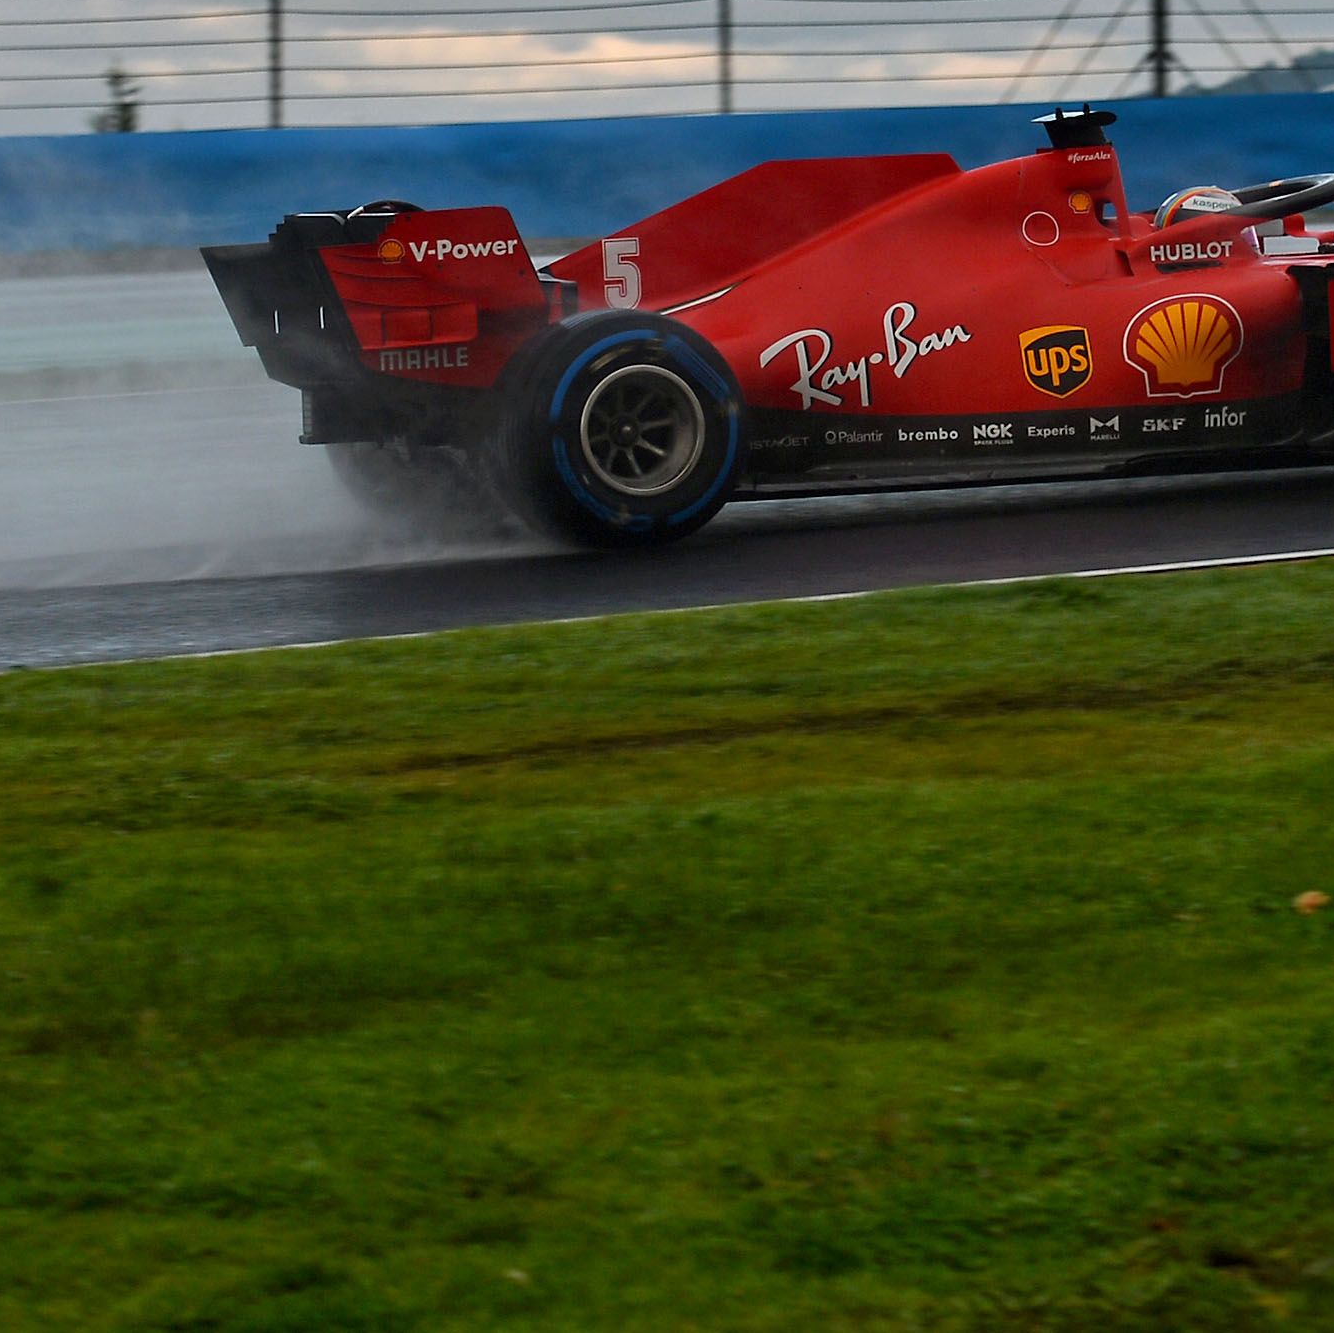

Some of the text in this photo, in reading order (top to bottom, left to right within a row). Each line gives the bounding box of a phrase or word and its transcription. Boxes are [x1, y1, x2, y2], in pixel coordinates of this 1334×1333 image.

[1068, 151, 1111, 164] #forzaAlex
[409, 239, 518, 263] V-Power
[1150, 241, 1233, 262] HUBLOT
[602, 237, 642, 310] 5
[379, 346, 469, 371] MAHLE
[1026, 344, 1090, 387] ups
[1142, 417, 1187, 433] SKF
[1204, 406, 1247, 428] infor
[838, 429, 885, 444] Palantir
[898, 426, 960, 442] brembo
[972, 423, 1013, 439] NGK
[1027, 424, 1076, 439] Experis
[1090, 433, 1121, 441] MARELLI
